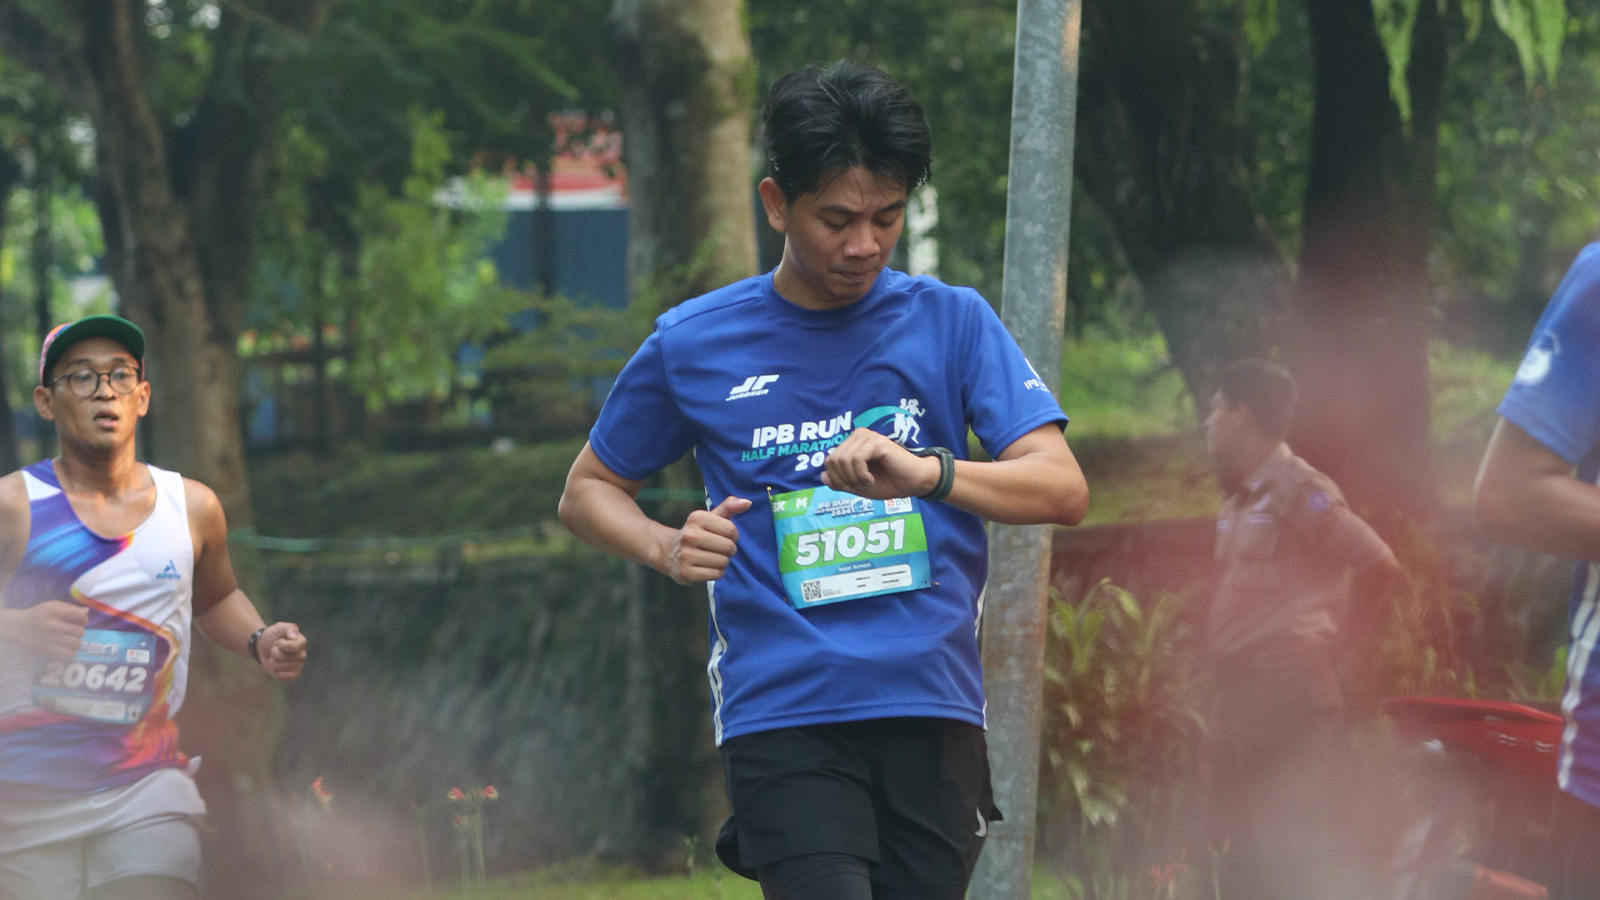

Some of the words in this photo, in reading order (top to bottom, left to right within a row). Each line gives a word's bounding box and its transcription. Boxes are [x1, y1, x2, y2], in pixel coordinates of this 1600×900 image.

[752, 423, 795, 449] IPB
[800, 410, 852, 442] RUN
[741, 446, 776, 462] HALF
[795, 446, 836, 472] 20
[794, 518, 906, 566] 51051
[41, 661, 148, 694] 20642
